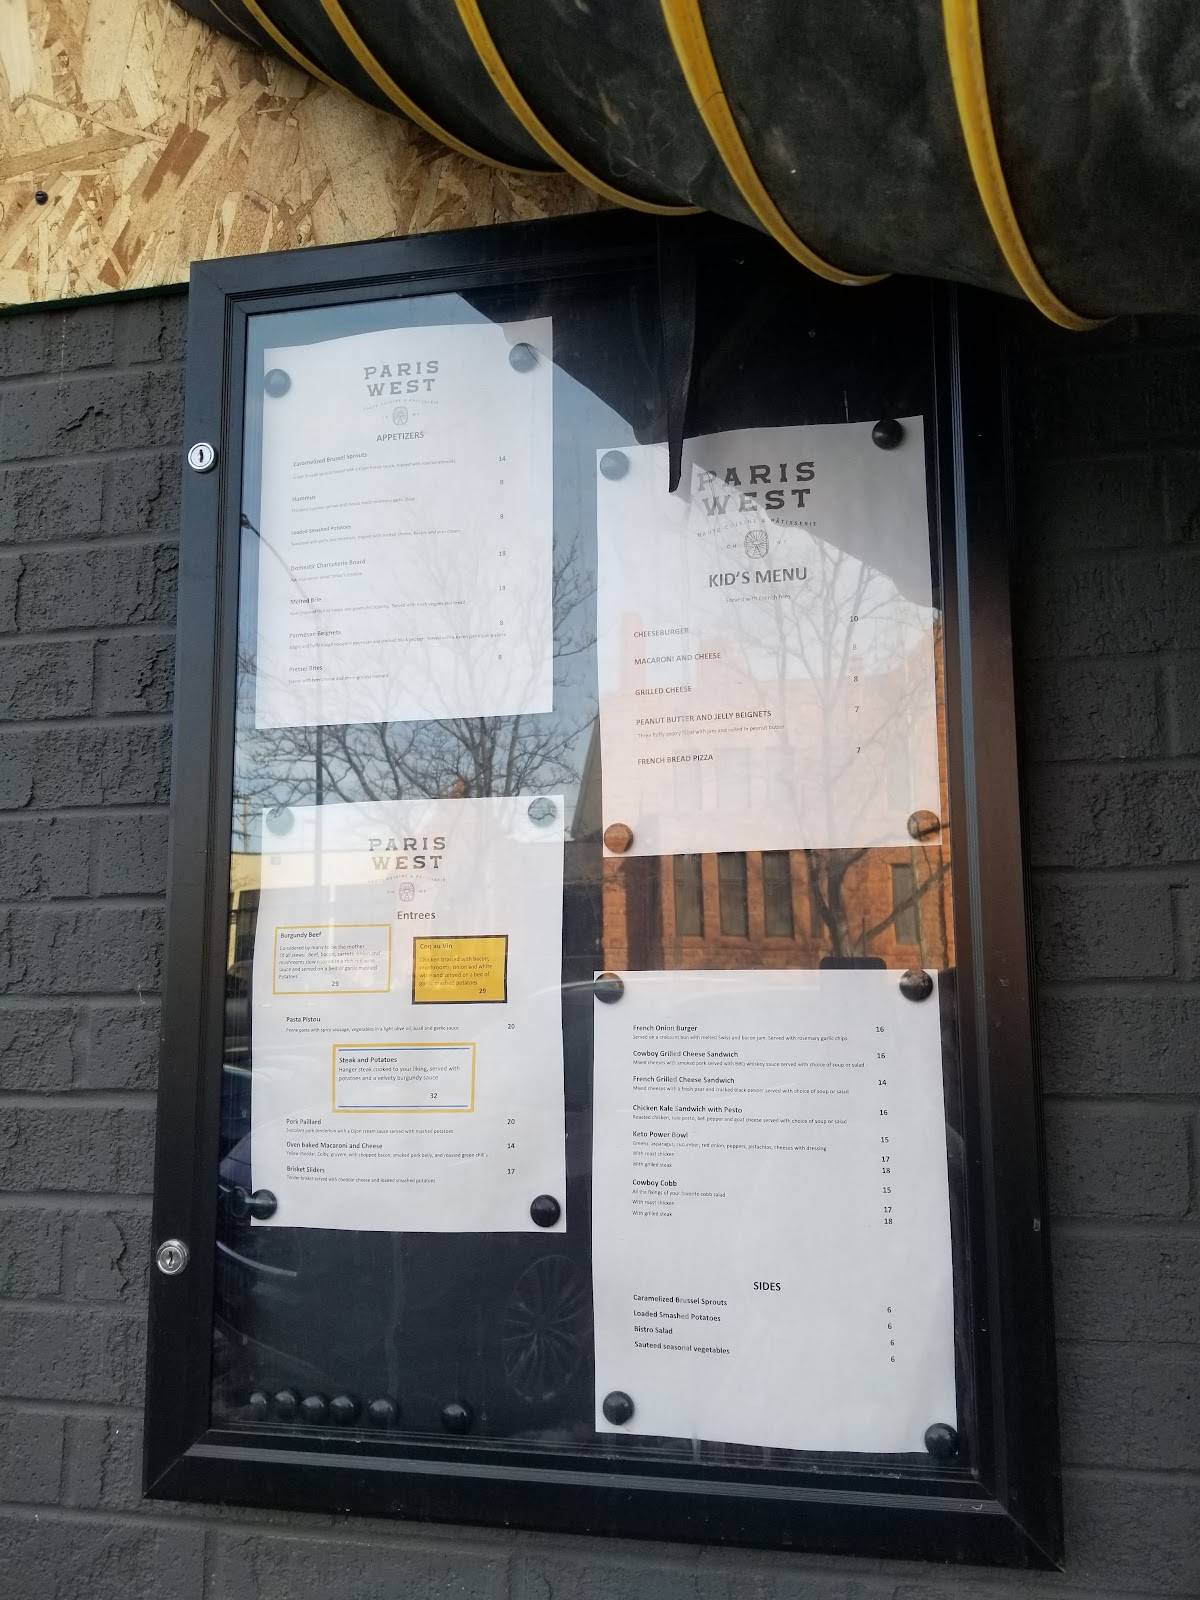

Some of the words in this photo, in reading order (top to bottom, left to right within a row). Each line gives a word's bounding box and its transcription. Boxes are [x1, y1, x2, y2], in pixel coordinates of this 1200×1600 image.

[363, 360, 439, 380] PARIS
[366, 378, 436, 397] WEST
[376, 430, 425, 443] APPETIZERS
[696, 461, 815, 491] PARIS
[702, 488, 811, 517] WEST
[709, 571, 750, 588] KID'S
[755, 567, 807, 584] MENU
[849, 615, 859, 623] 10
[633, 627, 689, 639] CHEESEBURGER
[634, 655, 674, 666] MACARONI
[676, 654, 693, 663] AND
[694, 651, 721, 662] CHEESE
[635, 687, 664, 696] GRILLED
[665, 685, 692, 694] CHEESE
[636, 716, 665, 726] PEANUT
[666, 714, 695, 724] BUTTER
[696, 713, 713, 722] AND
[714, 711, 734, 721] JELLY
[735, 709, 772, 720] BEIGNETS
[637, 757, 665, 766] FRENCH
[666, 755, 691, 764] BREAD
[692, 753, 714, 763] PIZZA
[368, 836, 446, 852] PARIS
[371, 855, 443, 870] WEST
[397, 910, 436, 920] Entrees
[280, 931, 308, 940] Burgundy
[308, 930, 322, 938] Beef
[632, 1024, 654, 1032] French
[676, 1025, 698, 1033] Burger
[632, 1050, 659, 1058] Cowboy
[632, 1075, 654, 1083] French
[703, 1076, 735, 1084] Sandwich
[632, 1104, 659, 1112] Chicken
[674, 1105, 706, 1113] Sandwich
[724, 1106, 743, 1114] Pesto
[632, 1130, 648, 1138] Keto
[671, 1131, 688, 1139] Bowl
[301, 1141, 319, 1149] baked
[881, 1155, 890, 1163] 17
[286, 1165, 306, 1173] Brisket
[632, 1179, 659, 1187] Cowboy
[753, 1281, 782, 1291] SIDES
[633, 1294, 674, 1303] Caramelized
[675, 1296, 700, 1304] Brussel
[701, 1298, 728, 1306] Sprouts
[633, 1310, 658, 1318] Loaded
[659, 1312, 689, 1320] Smashed
[690, 1313, 721, 1322] Potatoes
[634, 1325, 654, 1333] Bistro
[655, 1327, 673, 1335] Salad
[887, 1322, 893, 1330] 6
[663, 1343, 692, 1351] seasonal
[693, 1345, 730, 1355] vegetables
[890, 1355, 896, 1363] 6
